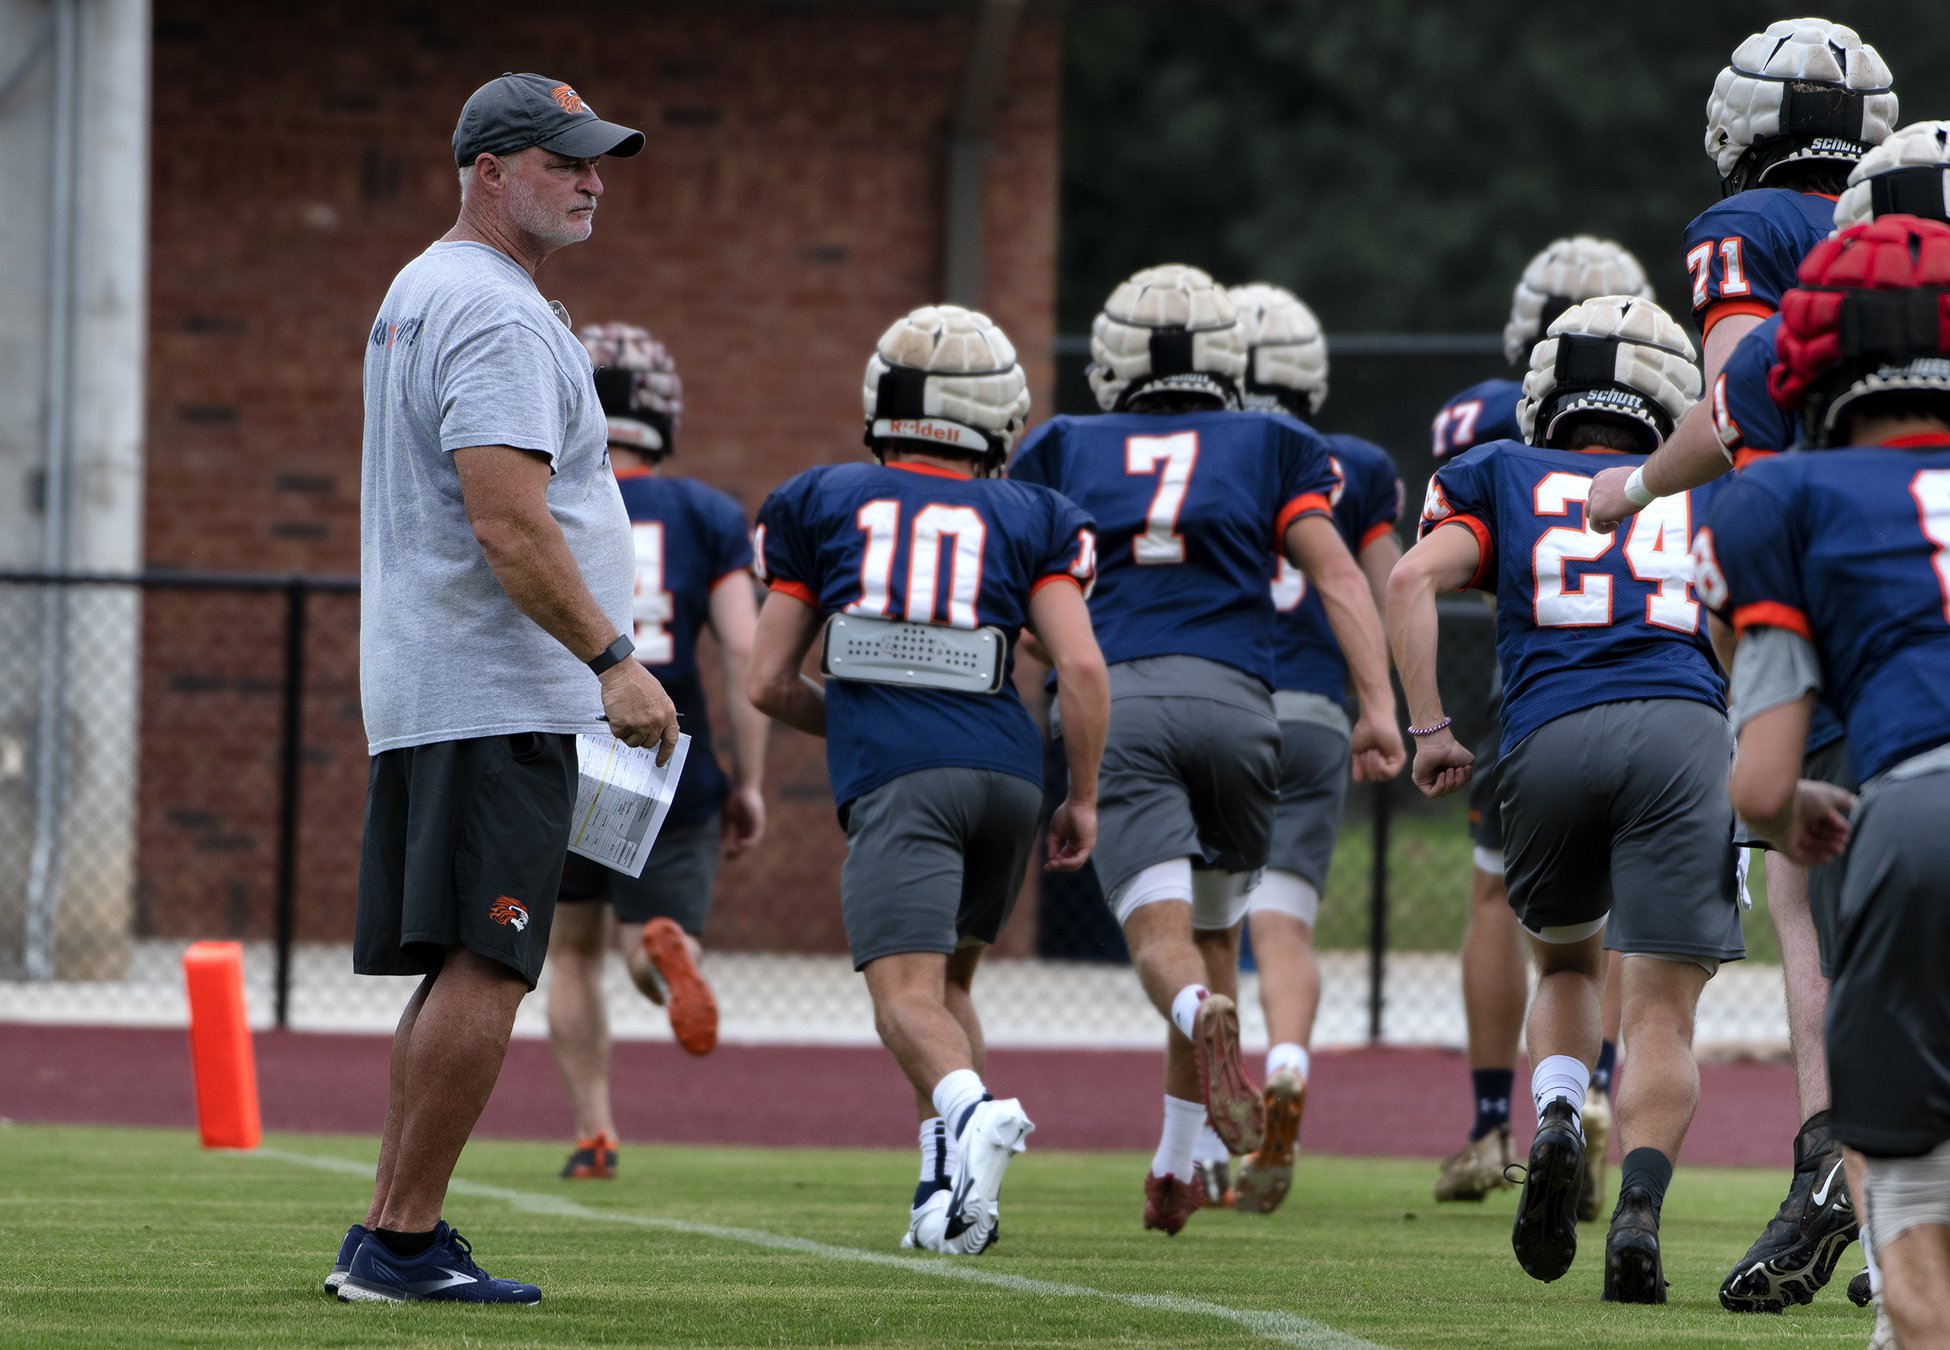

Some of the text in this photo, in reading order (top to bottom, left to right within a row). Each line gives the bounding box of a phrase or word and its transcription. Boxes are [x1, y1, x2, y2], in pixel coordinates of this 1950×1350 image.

[1686, 236, 1751, 310] 71
[844, 498, 987, 630] 10
[1125, 430, 1199, 566] 7
[1532, 471, 1700, 636] 24
